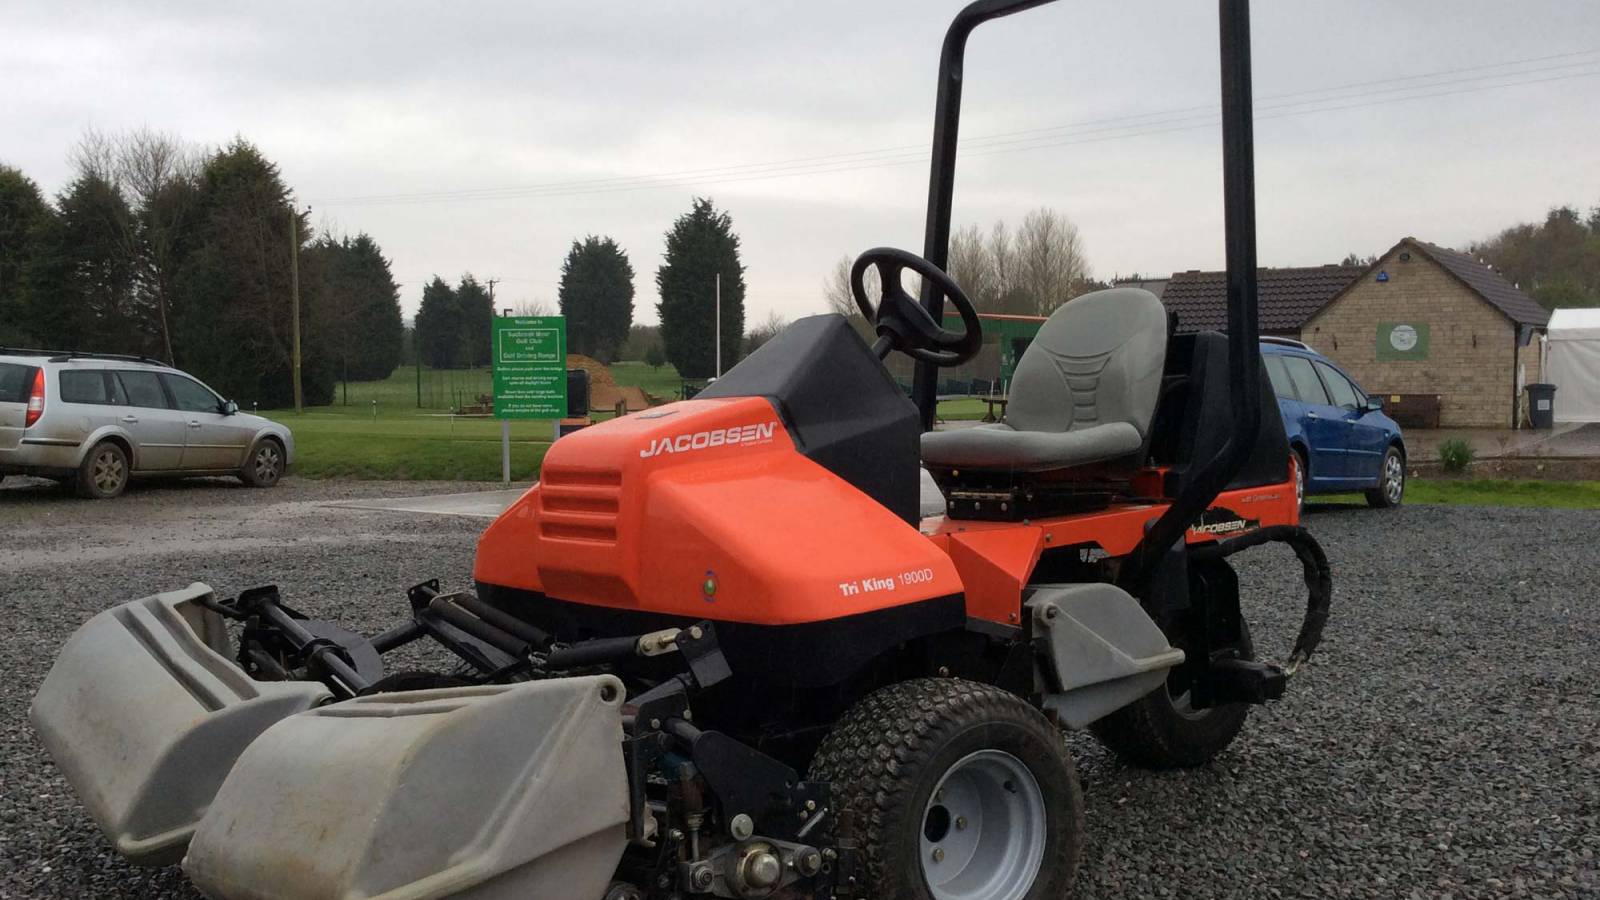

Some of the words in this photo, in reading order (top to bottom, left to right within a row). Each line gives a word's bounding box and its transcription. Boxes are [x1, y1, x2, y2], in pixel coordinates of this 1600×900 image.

[639, 421, 777, 458] JACOBSEN
[839, 581, 859, 597] Tri
[862, 577, 895, 592] King
[897, 568, 934, 585] 1900D
